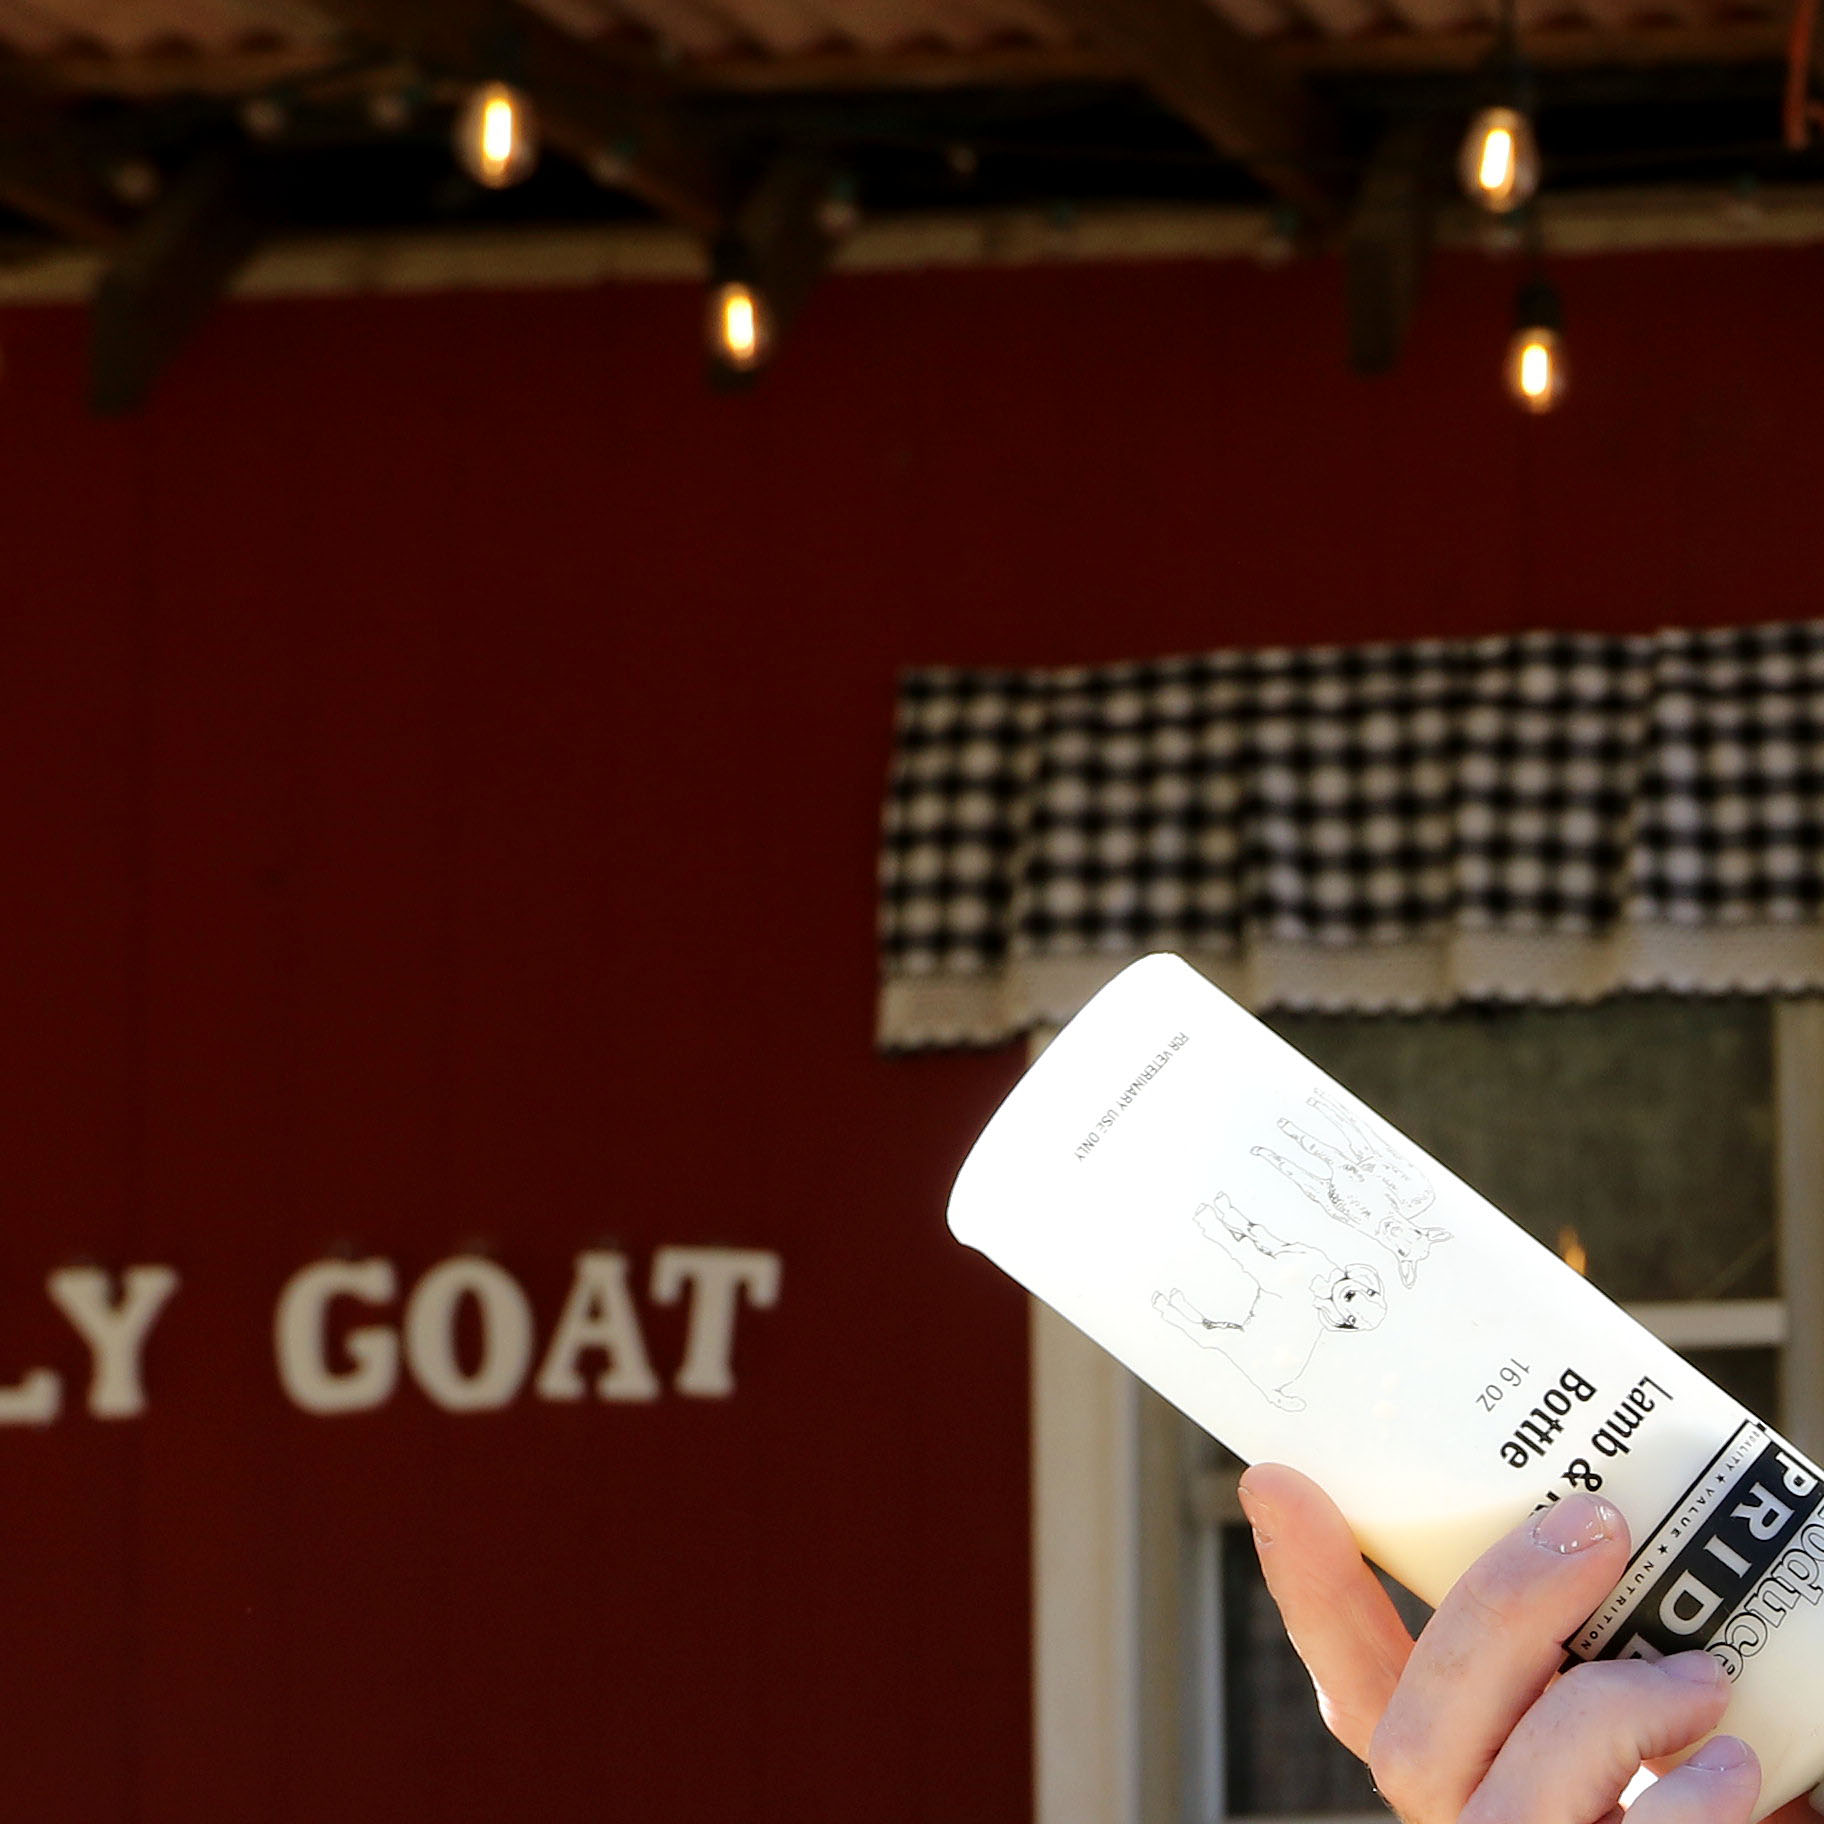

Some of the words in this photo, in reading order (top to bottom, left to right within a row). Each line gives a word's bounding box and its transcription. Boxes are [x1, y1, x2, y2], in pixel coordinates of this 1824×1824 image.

[1168, 1031, 1190, 1052] FOR
[1115, 1050, 1174, 1111] VETERINARY
[1096, 1108, 1120, 1134] USE
[1073, 1132, 1101, 1162] ONLY
[274, 1246, 782, 1416] GOAT
[1499, 1357, 1531, 1388] 16
[1475, 1384, 1504, 1413] oz
[1500, 1368, 1598, 1469] Bottle
[1590, 1376, 1674, 1458] Lamb
[1723, 1430, 1761, 1473] QUALITY
[1561, 1458, 1603, 1493] &
[1669, 1488, 1715, 1538] VALUE
[1579, 1560, 1656, 1653] NUTRITION
